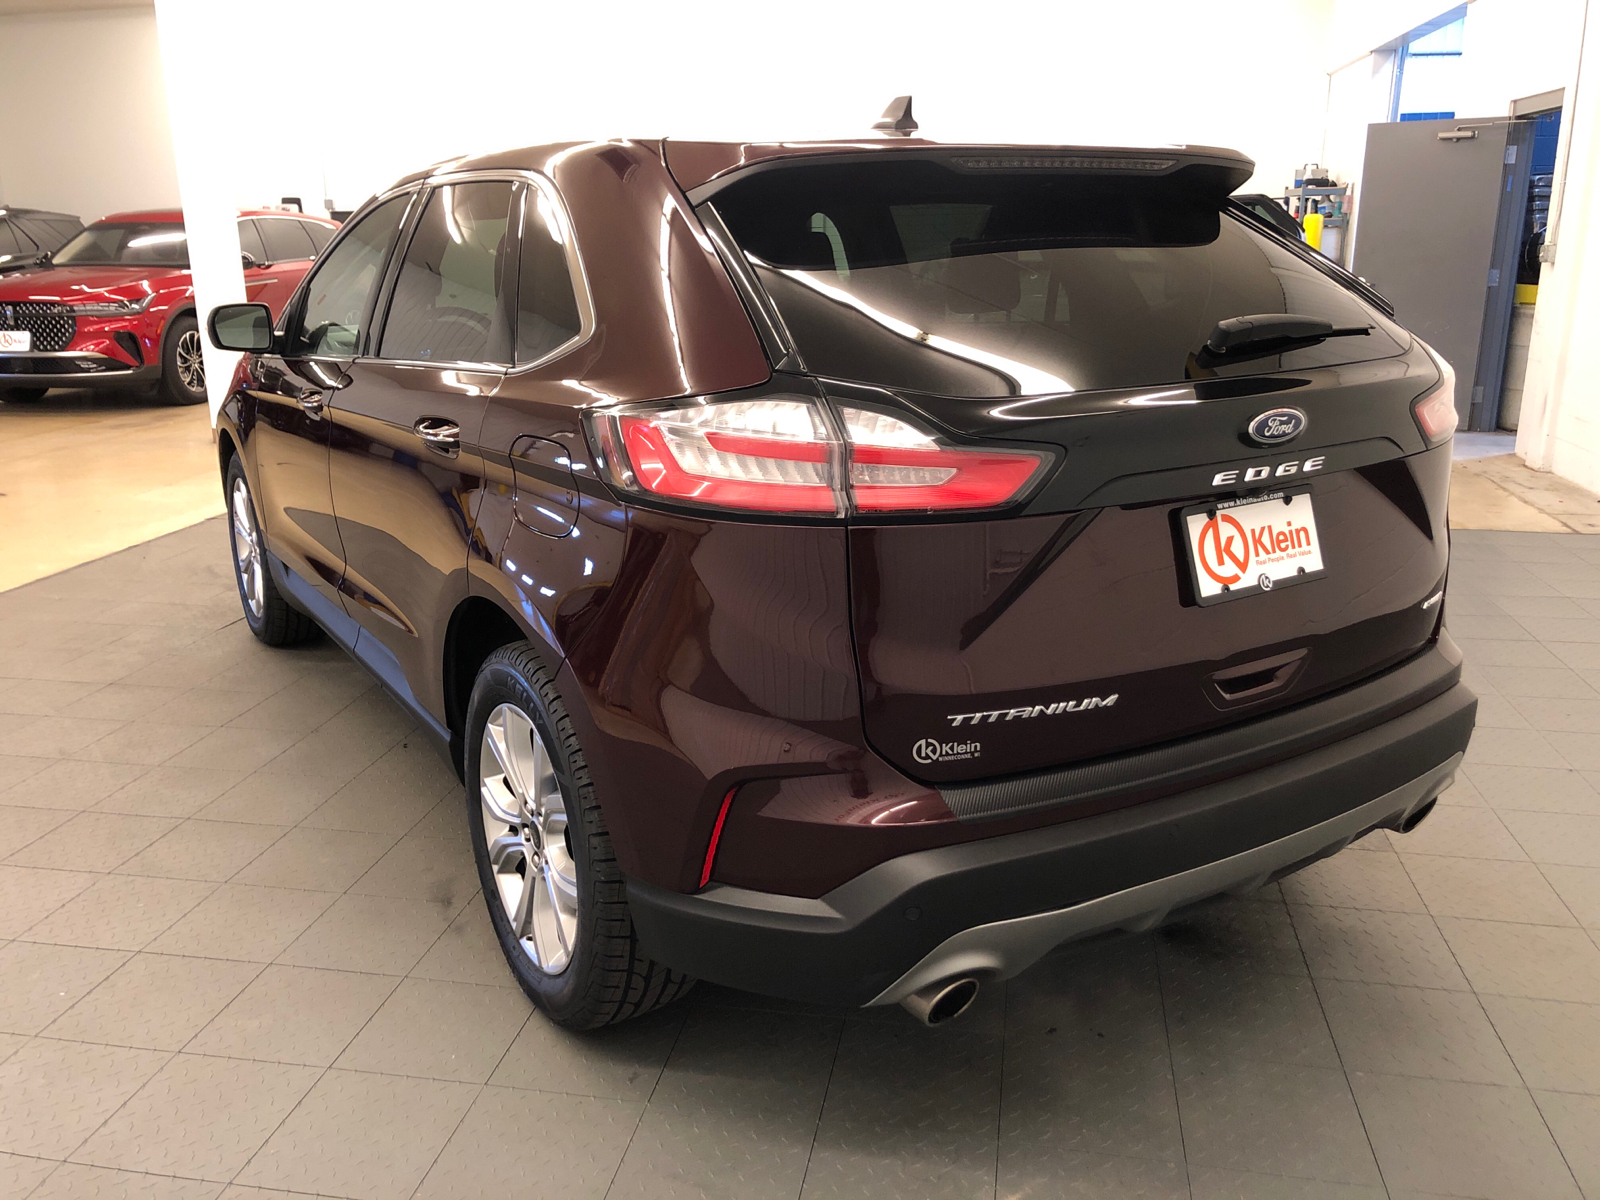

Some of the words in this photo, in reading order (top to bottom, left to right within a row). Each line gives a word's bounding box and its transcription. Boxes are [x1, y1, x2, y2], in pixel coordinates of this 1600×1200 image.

[1264, 417, 1295, 436] Ford
[1212, 456, 1326, 486] EDGE
[1250, 521, 1311, 557] Klein
[1267, 555, 1286, 564] People.
[1286, 551, 1298, 559] Real
[1297, 549, 1313, 557] Value.
[947, 693, 1119, 727] TITANIUM
[942, 740, 981, 755] Klein
